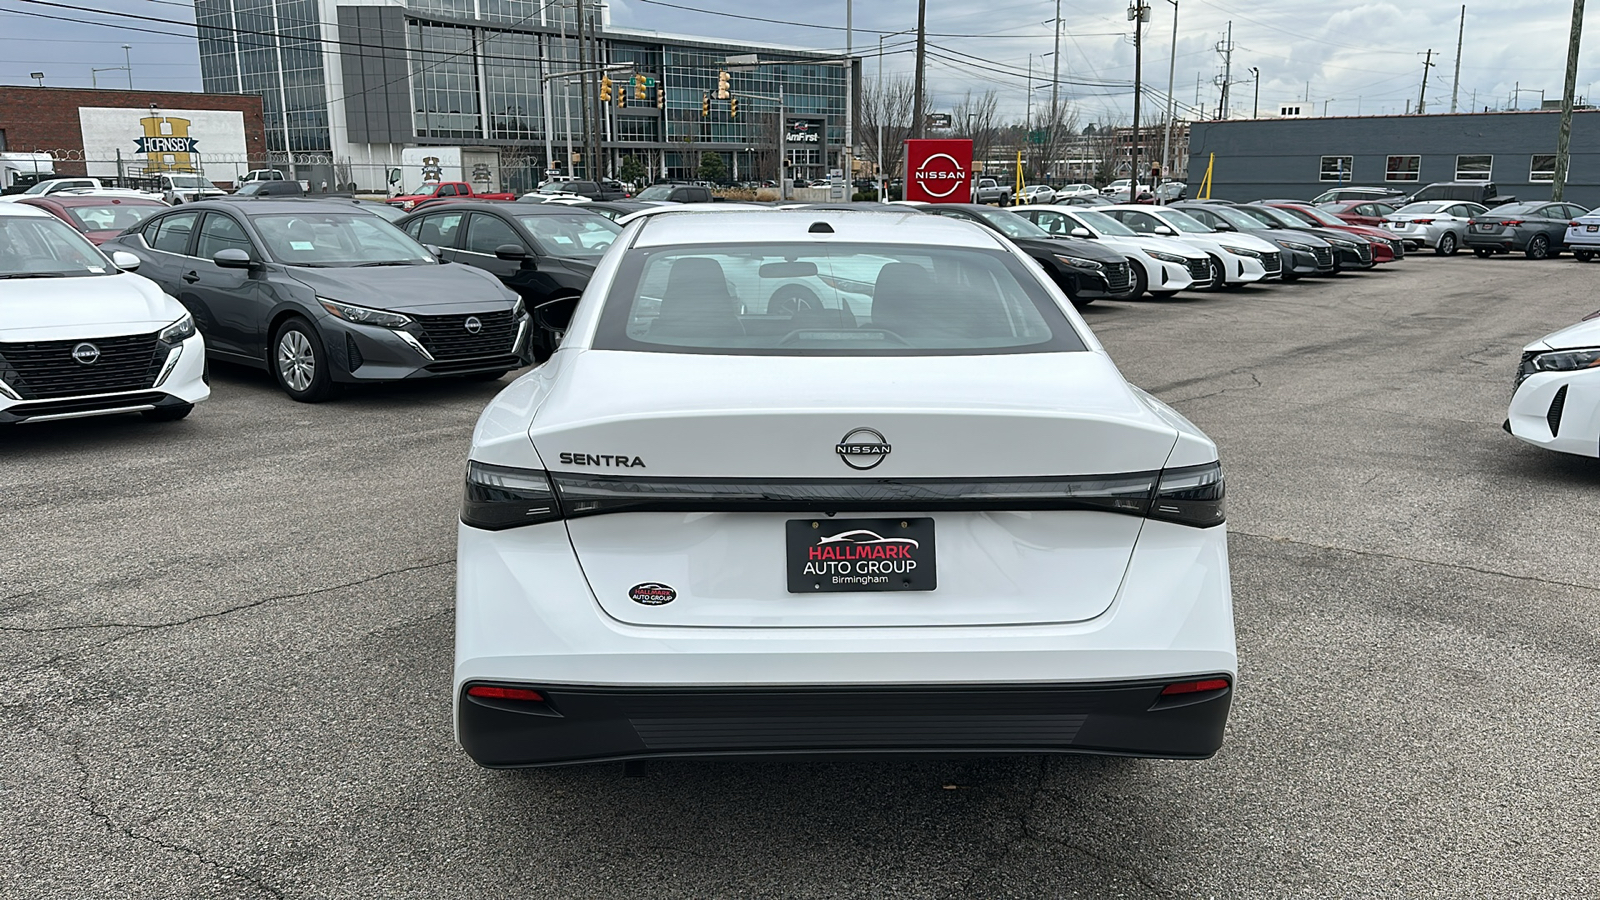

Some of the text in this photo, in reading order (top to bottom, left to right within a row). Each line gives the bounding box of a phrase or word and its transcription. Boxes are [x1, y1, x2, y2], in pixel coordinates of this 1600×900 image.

[786, 132, 819, 142] AmFirst
[143, 137, 191, 152] HORNSBY
[915, 171, 966, 179] NISSAN
[837, 446, 890, 454] NISSAN
[559, 452, 646, 468] SENTRA
[808, 545, 912, 560] HALLMARK
[803, 560, 917, 575] AUTO GROUP
[832, 575, 889, 585] Birmingham
